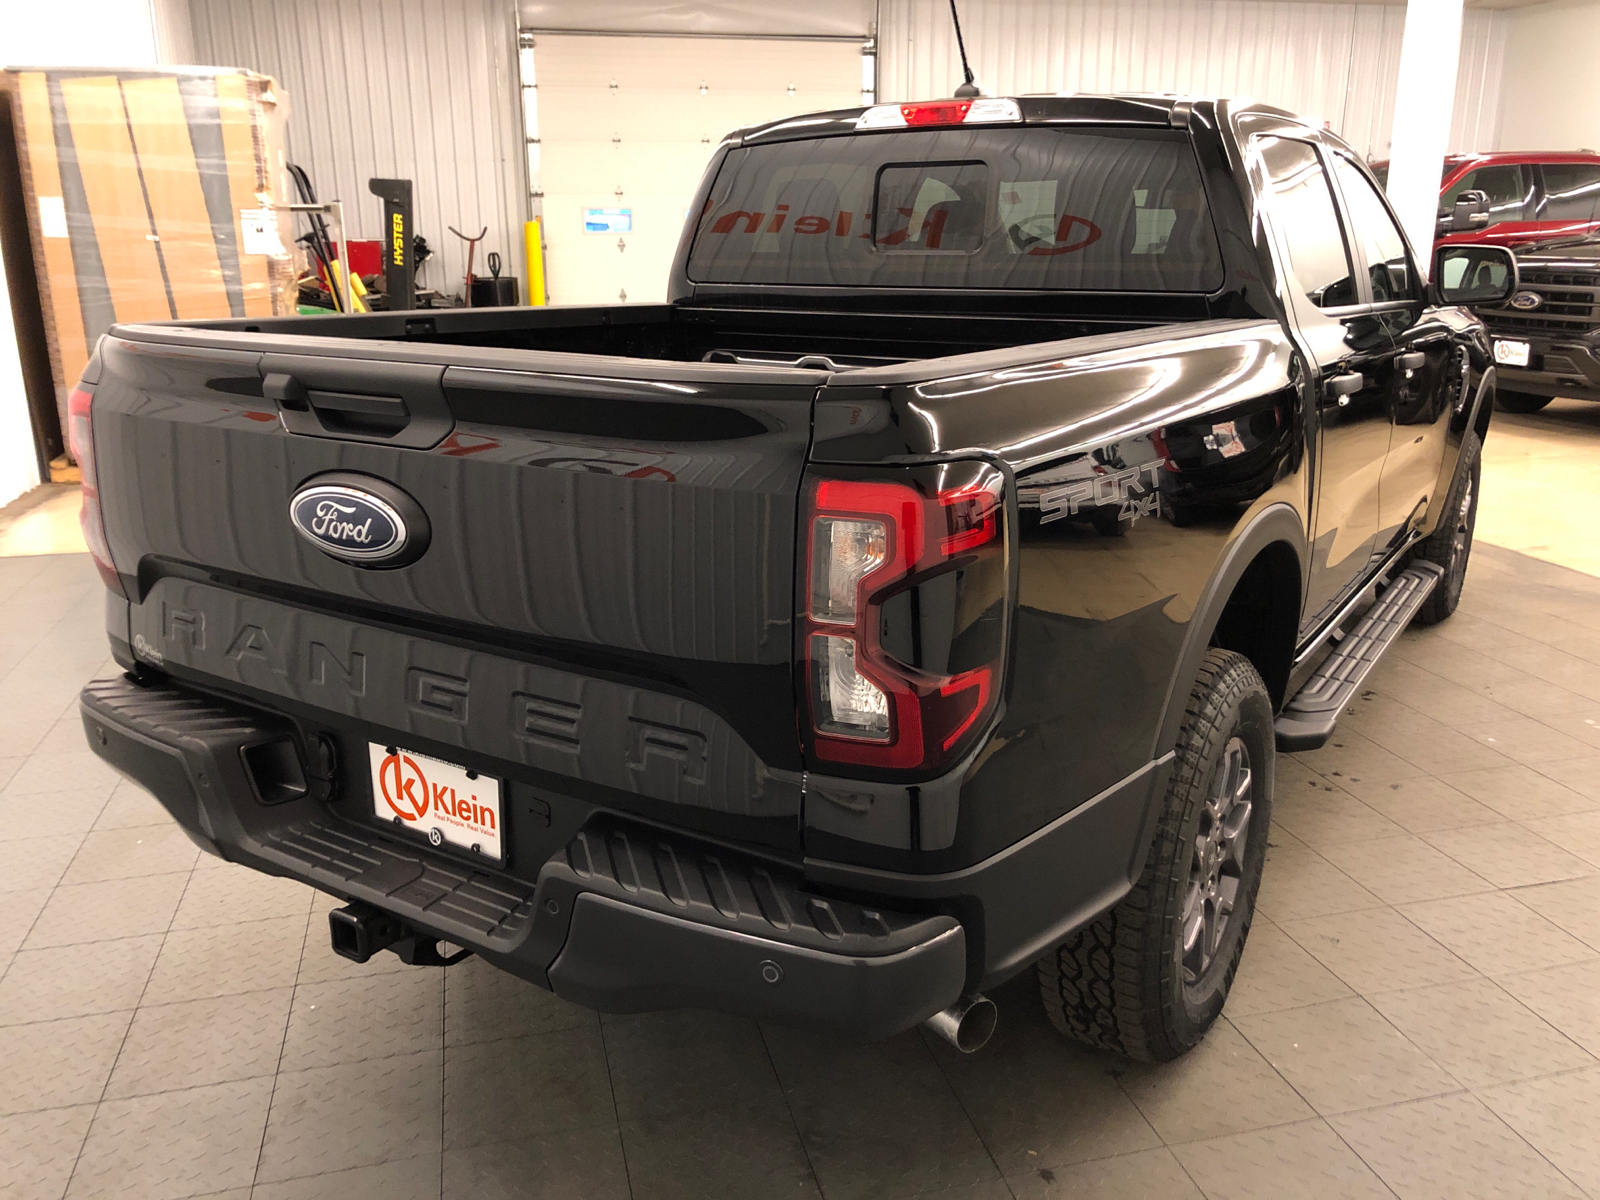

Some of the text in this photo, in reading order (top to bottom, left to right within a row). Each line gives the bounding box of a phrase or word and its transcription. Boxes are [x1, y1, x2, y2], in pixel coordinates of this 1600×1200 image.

[392, 212, 404, 267] HYSTER
[1039, 456, 1166, 525] SPORT
[311, 500, 373, 544] Ford
[162, 600, 708, 786] RANGER
[432, 781, 496, 830] Klein
[434, 812, 497, 838] Real People. Real Value.
